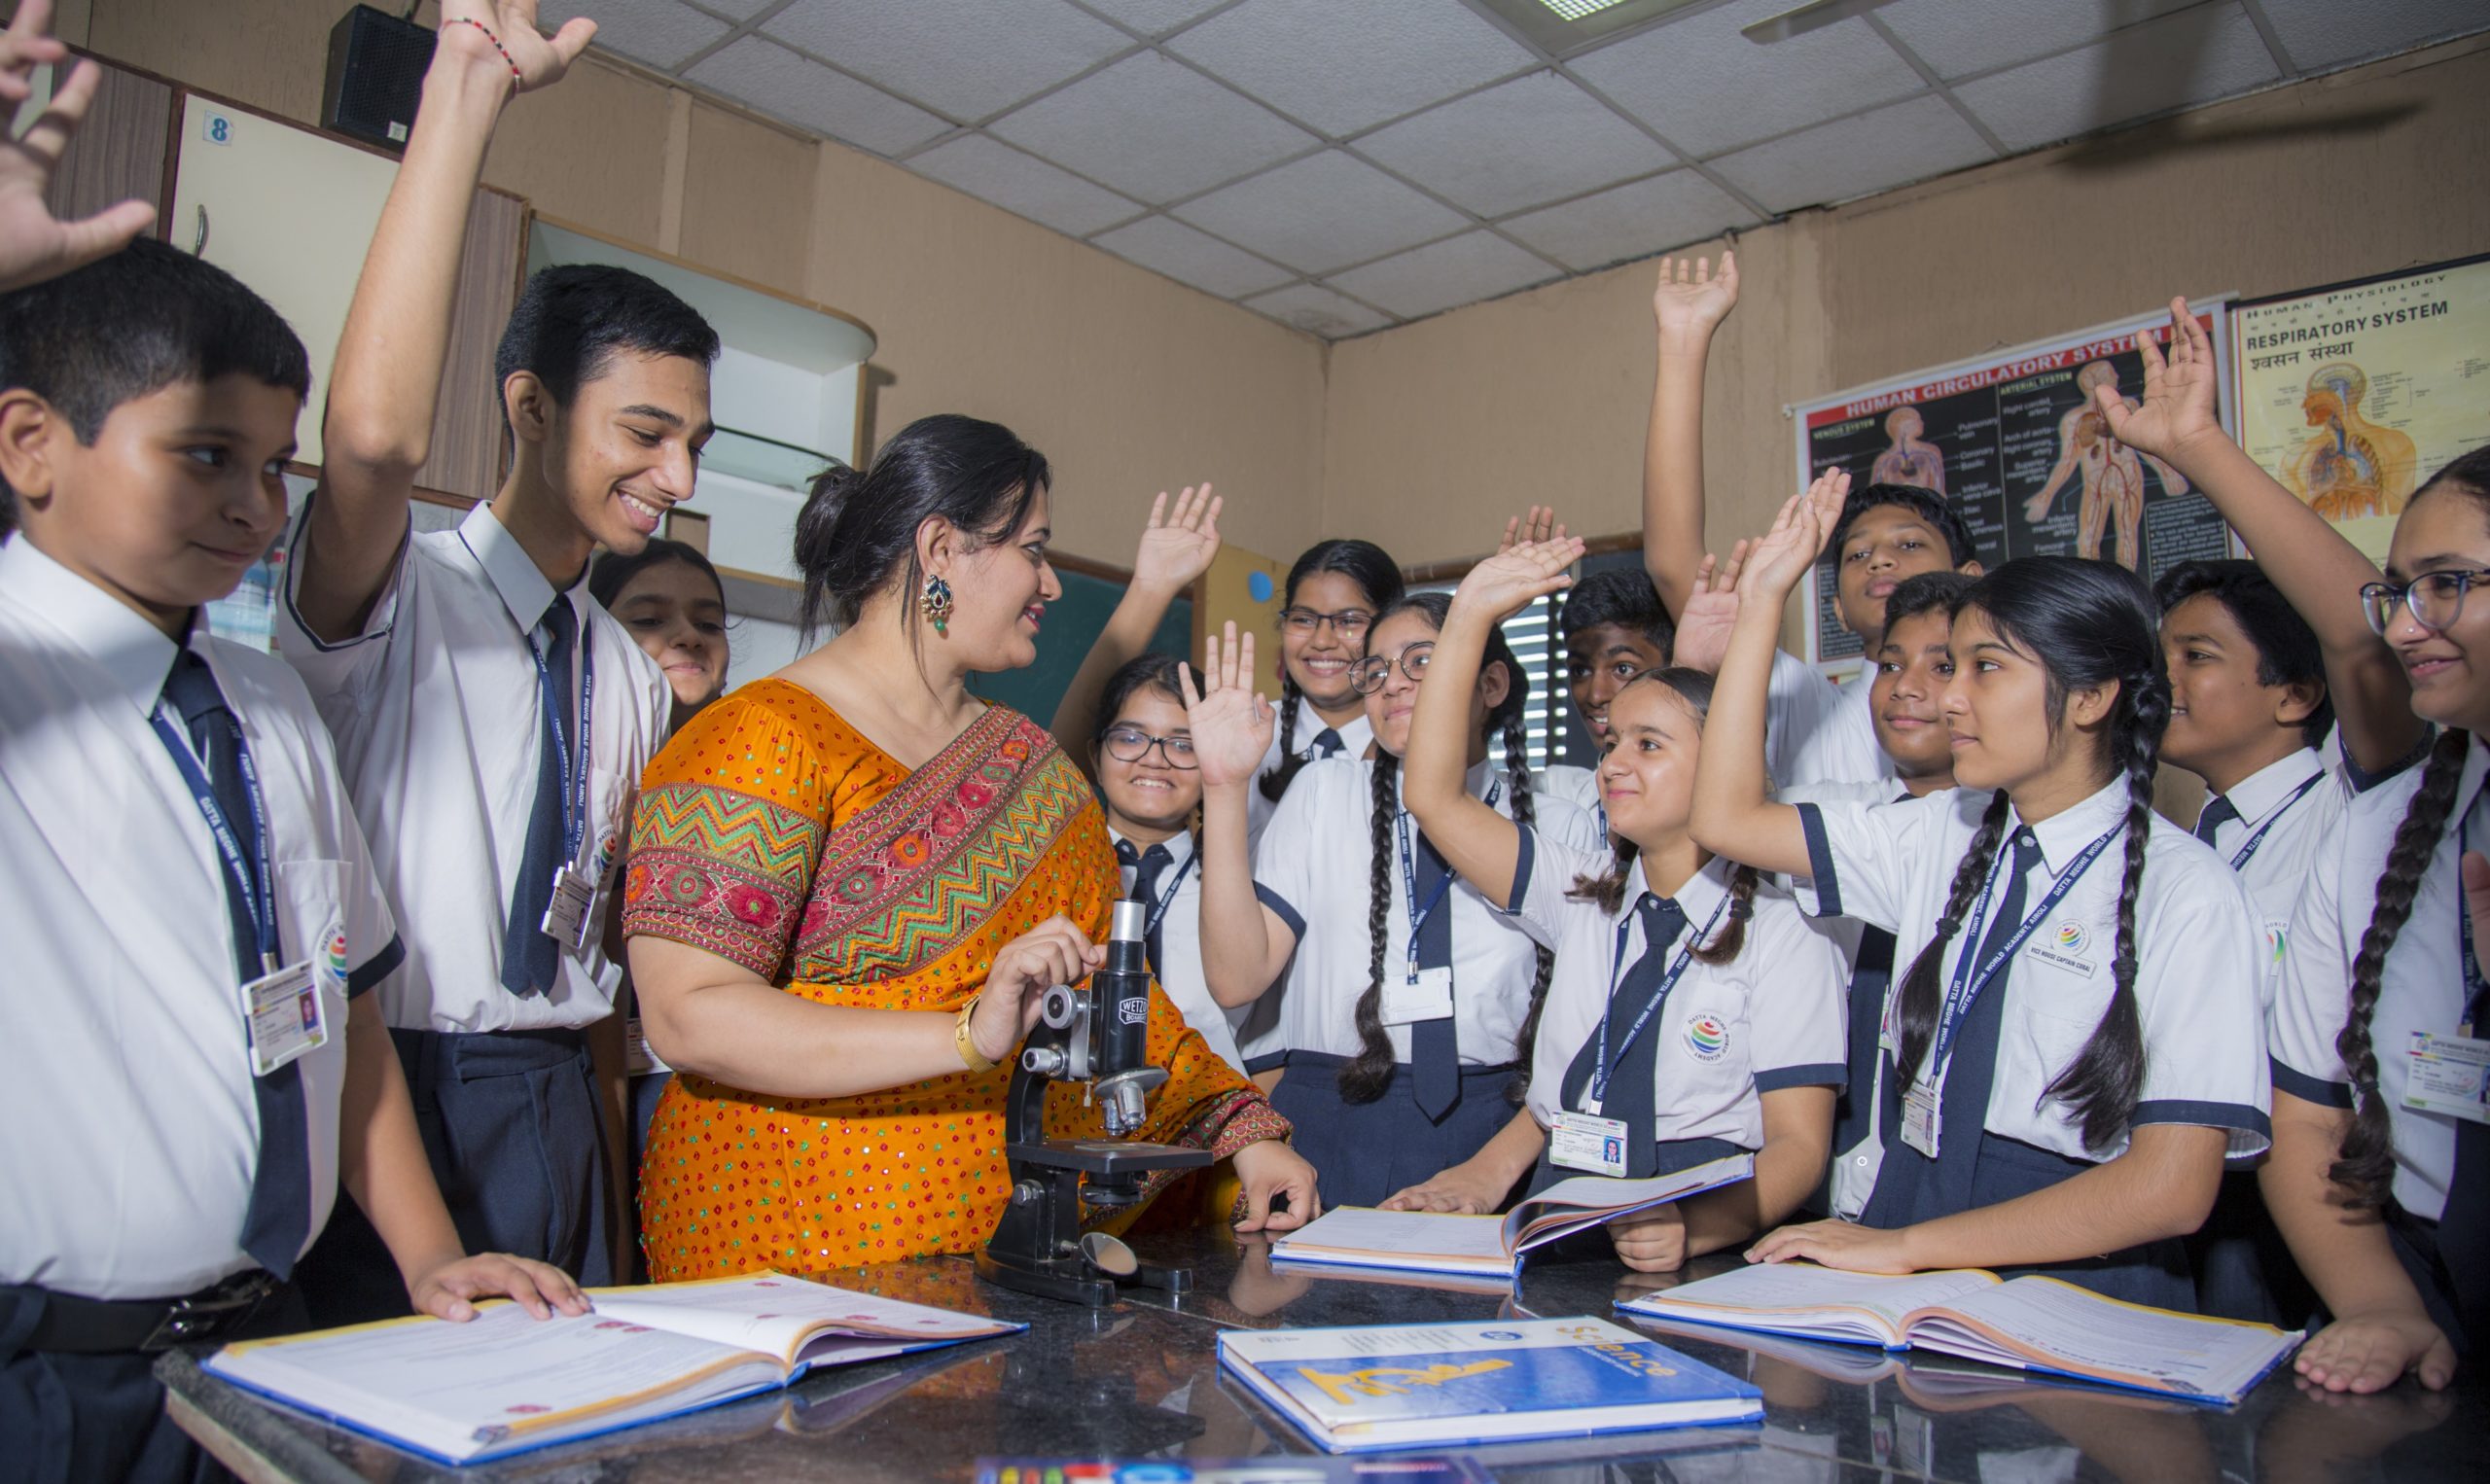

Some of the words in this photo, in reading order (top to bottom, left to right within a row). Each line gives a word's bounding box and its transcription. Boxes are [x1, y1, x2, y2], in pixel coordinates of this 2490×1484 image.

[212, 118, 228, 141] 8
[2247, 301, 2313, 319] HUMAN
[2328, 274, 2446, 304] PHYSIOLOGY
[2247, 317, 2367, 350] RESPIRATORY
[2372, 300, 2448, 328] SYSTEM
[2250, 350, 2300, 371] श्वसन
[2308, 341, 2354, 361] संस्था
[1847, 385, 1920, 418] HUMAN
[1923, 353, 2067, 401] CIRCULATORY
[2073, 329, 2162, 364] SYSTM
[199, 796, 222, 828] DATTA
[215, 827, 239, 860] MEGHE
[2247, 833, 2264, 851] DATTA
[2053, 877, 2073, 897] DATTA
[2069, 857, 2090, 878] MEGHE
[2086, 836, 2108, 857] WORLD
[1970, 914, 1981, 936] AIROLI
[1959, 994, 1973, 1014] DATTA
[1971, 972, 1987, 994] MEGHE
[1985, 951, 2006, 972] WORLD
[2005, 925, 2032, 952] ACADEMY,
[2029, 905, 2048, 925] AIROLI
[2056, 956, 2076, 967] CAPTAIN
[1660, 975, 1674, 992] DATTA
[1951, 980, 1962, 1001] DATTA
[1634, 1010, 1651, 1029] WORLD
[1944, 1002, 1955, 1026] MEGHE
[1556, 1325, 1678, 1377] Science
